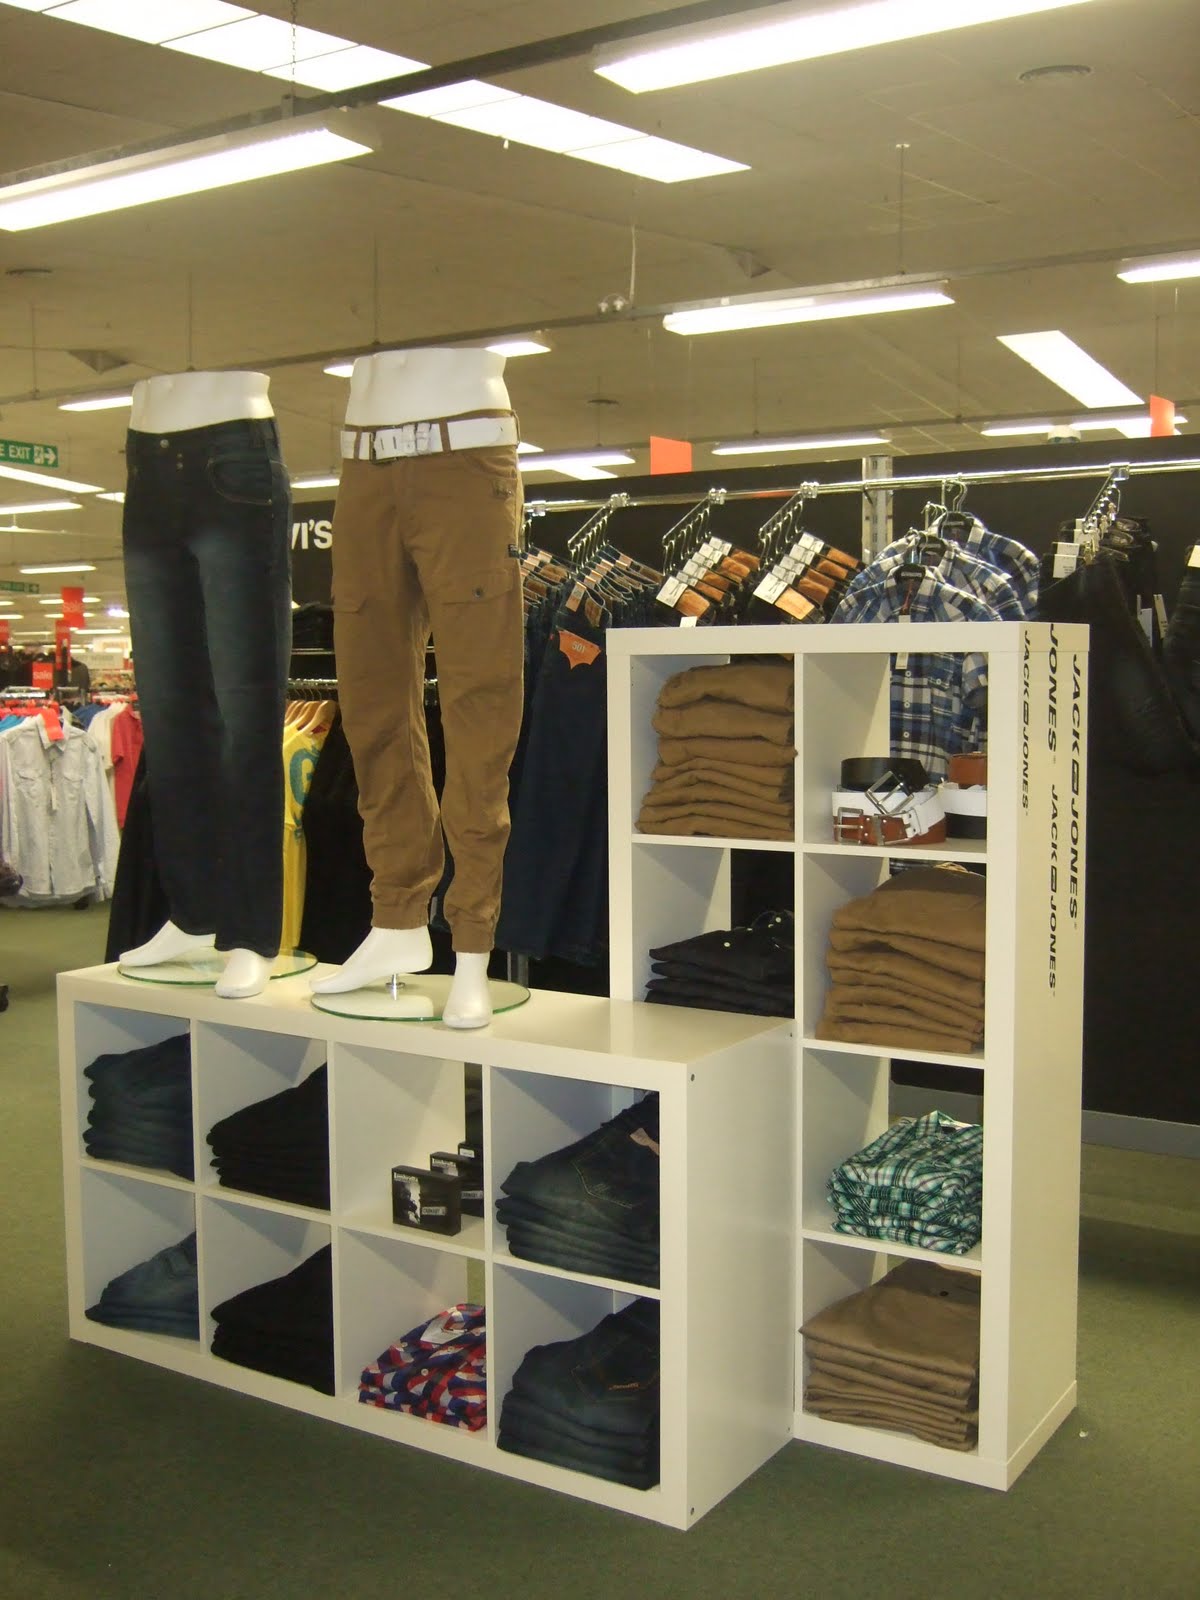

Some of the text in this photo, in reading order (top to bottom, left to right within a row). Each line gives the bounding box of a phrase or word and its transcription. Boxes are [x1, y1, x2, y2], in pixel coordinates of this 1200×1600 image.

[9, 445, 31, 459] EXIT
[1048, 623, 1058, 752] JONES
[1069, 653, 1080, 919] JACK JONES
[1049, 895, 1057, 988] JONES
